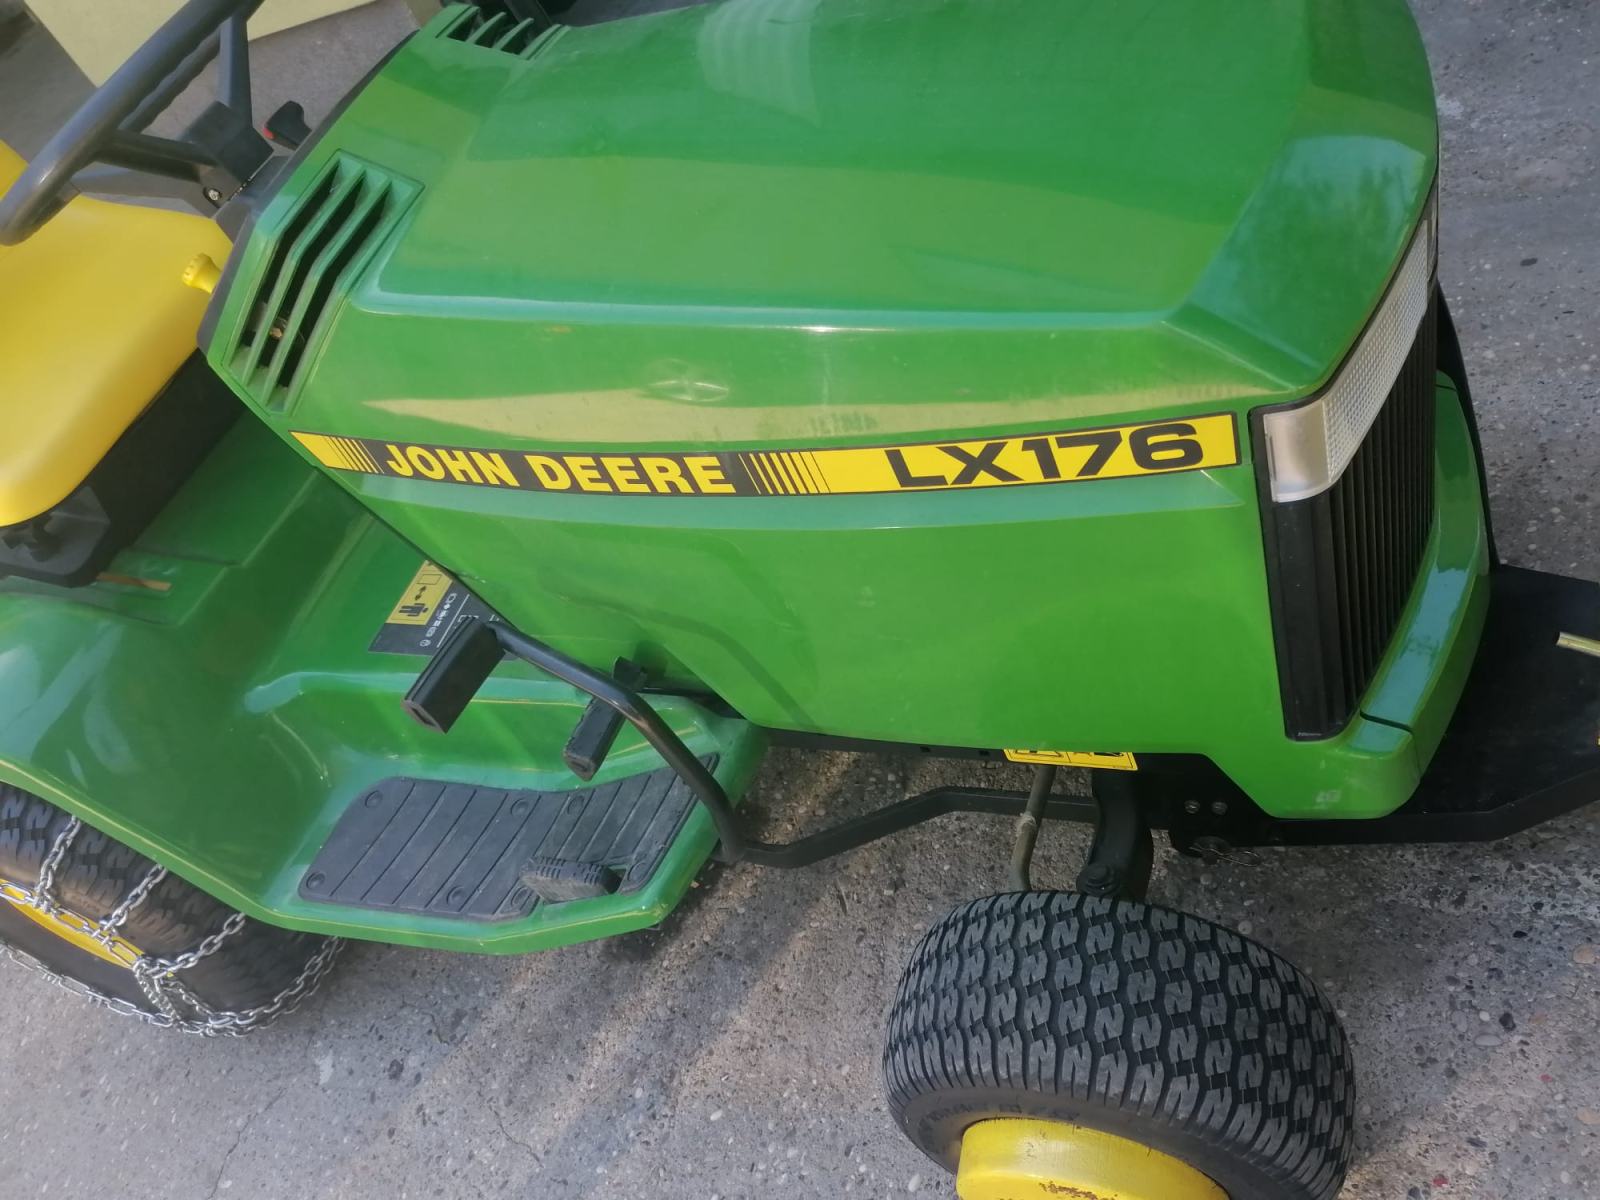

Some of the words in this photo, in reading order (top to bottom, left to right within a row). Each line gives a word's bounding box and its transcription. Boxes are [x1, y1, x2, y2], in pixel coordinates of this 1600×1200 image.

[386, 444, 520, 487] JOHN
[523, 454, 737, 494] DEERE
[883, 423, 1203, 488] LX176
